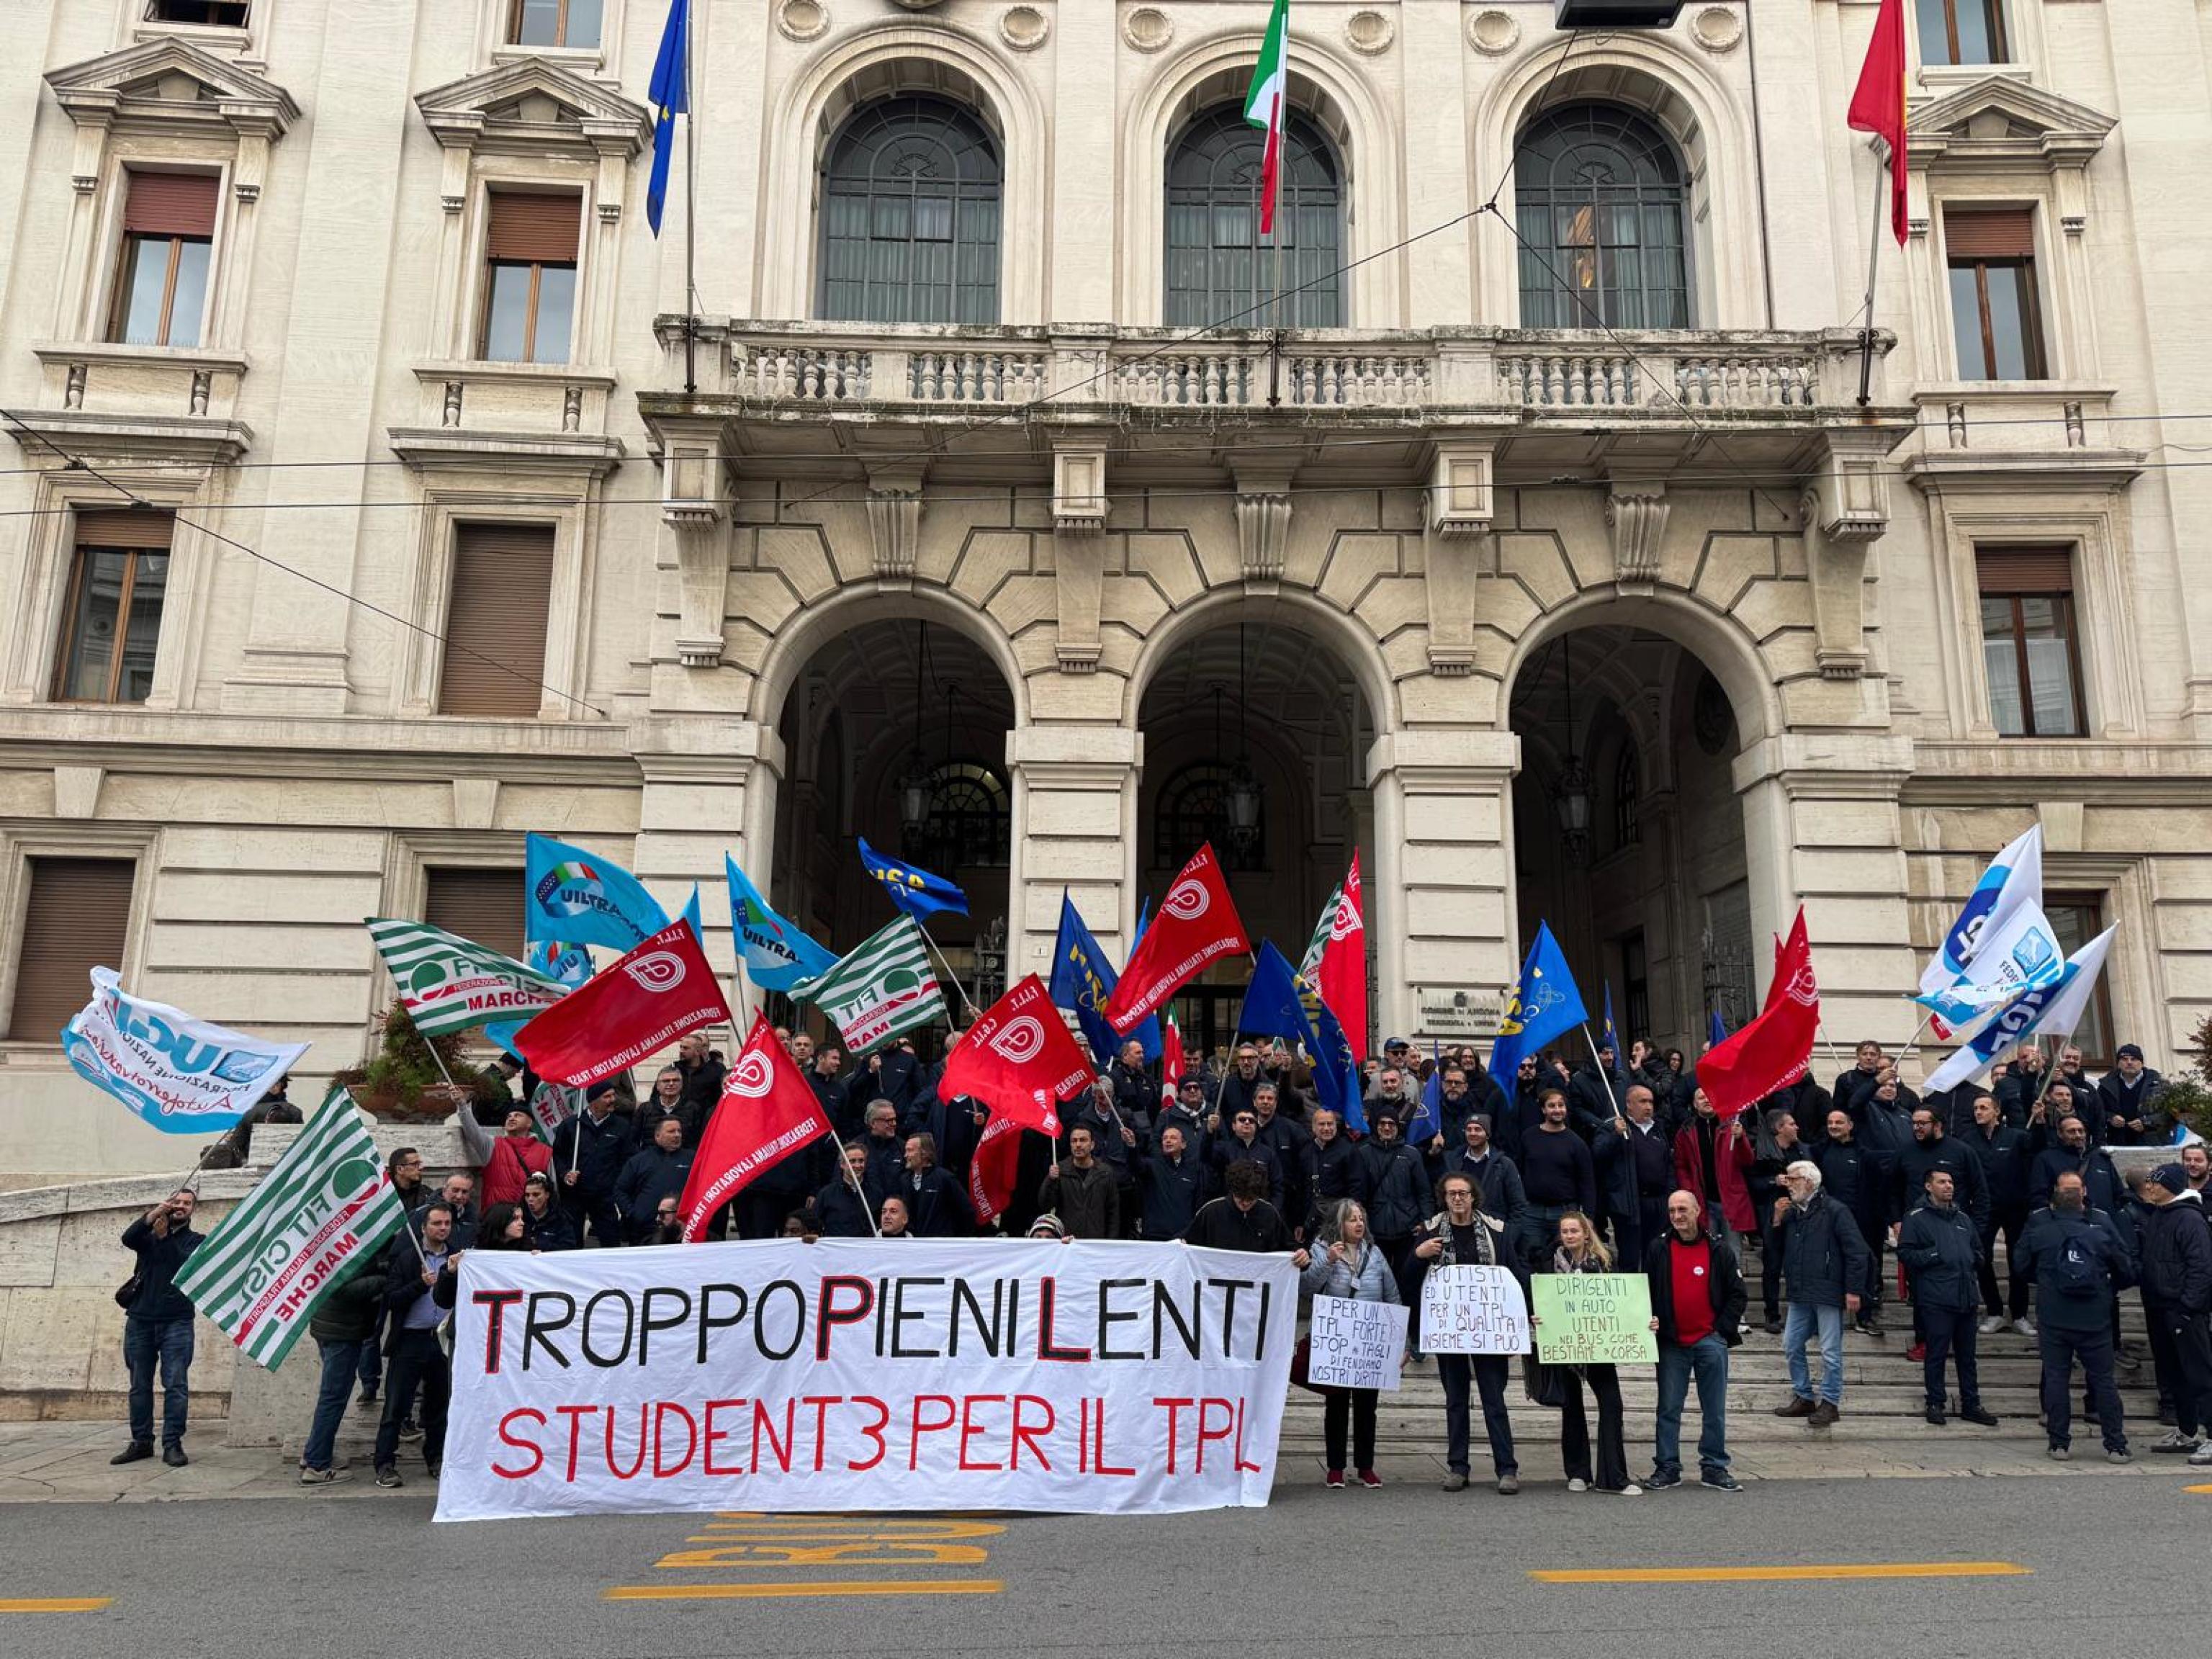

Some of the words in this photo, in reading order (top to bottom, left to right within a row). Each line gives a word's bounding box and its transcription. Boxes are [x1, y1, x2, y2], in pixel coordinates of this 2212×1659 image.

[1443, 1285, 1506, 1301] UTENTI
[1556, 1277, 1628, 1296] DIRIGENTI
[1331, 1298, 1358, 1318] PER
[1364, 1304, 1379, 1321] UN
[1430, 1303, 1449, 1318] PER
[1455, 1304, 1470, 1317] UN
[1479, 1302, 1508, 1318] TPL
[1565, 1300, 1575, 1314] IN
[1582, 1299, 1616, 1314] AUTO
[1038, 1276, 1270, 1362] LENTI
[1318, 1316, 1342, 1336] TPL
[1439, 1318, 1447, 1329] DI
[1572, 1316, 1619, 1333] UTENTI
[1311, 1335, 1349, 1354] STOP
[1423, 1333, 1464, 1350] INSIEME
[1471, 1334, 1485, 1349] SI
[1559, 1335, 1573, 1344] NEI
[1578, 1334, 1604, 1344] BUS
[1609, 1334, 1639, 1344] COME
[1542, 1345, 1597, 1361] BESTIAME
[491, 1395, 891, 1483] STUDENT3
[909, 1394, 1057, 1471] PER
[1079, 1397, 1136, 1476] IL
[1153, 1396, 1261, 1476] TPL
